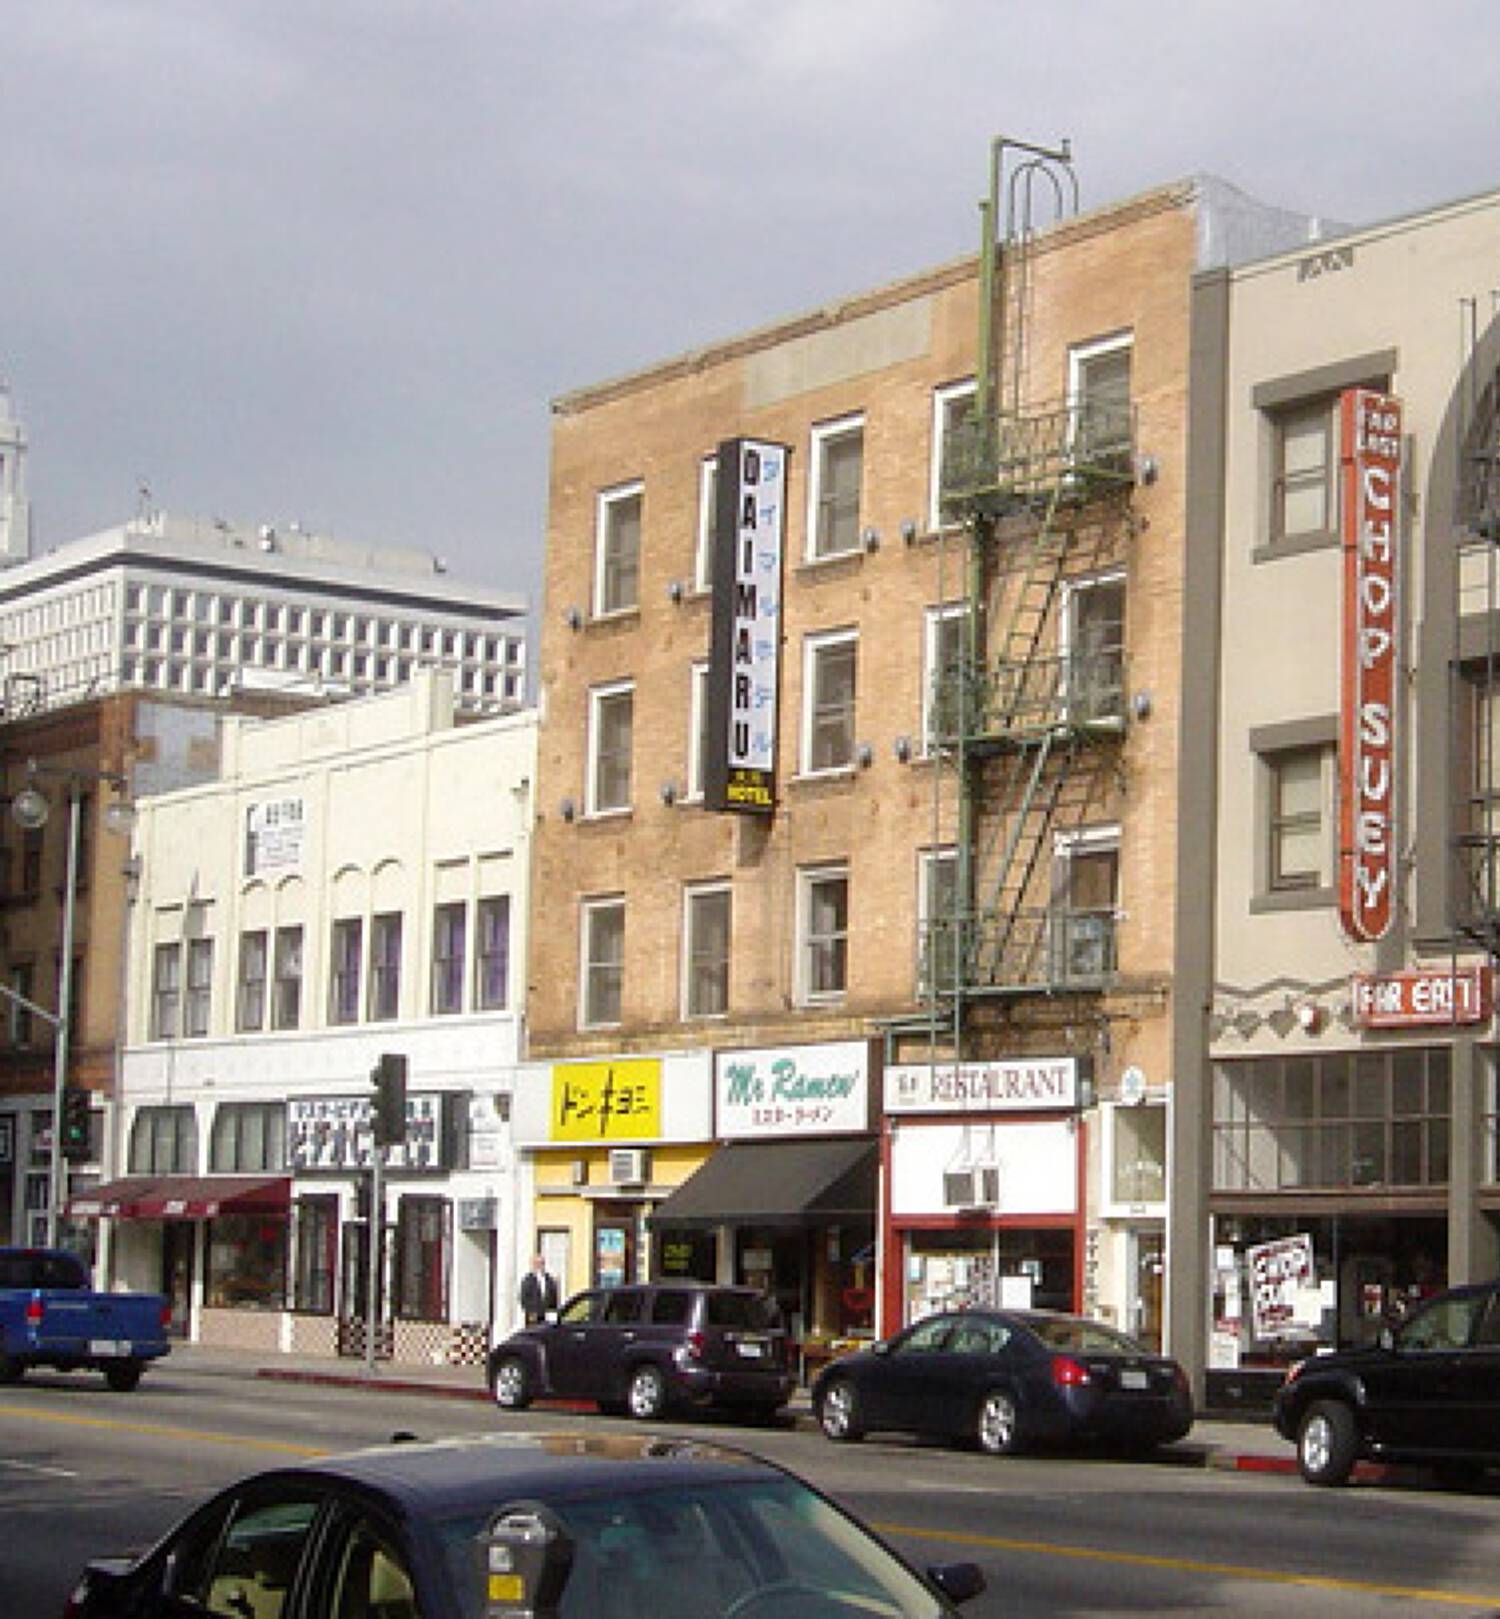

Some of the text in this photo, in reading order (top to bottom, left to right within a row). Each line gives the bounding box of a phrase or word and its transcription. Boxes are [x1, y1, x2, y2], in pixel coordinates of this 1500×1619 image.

[734, 448, 761, 760] DAIMARU
[1358, 467, 1392, 908] CHOP SUEY
[727, 783, 773, 805] HOTEL
[1359, 978, 1473, 1013] FAR EAST
[769, 1057, 861, 1103] Ramen
[930, 1065, 1069, 1101] RESTAURANT
